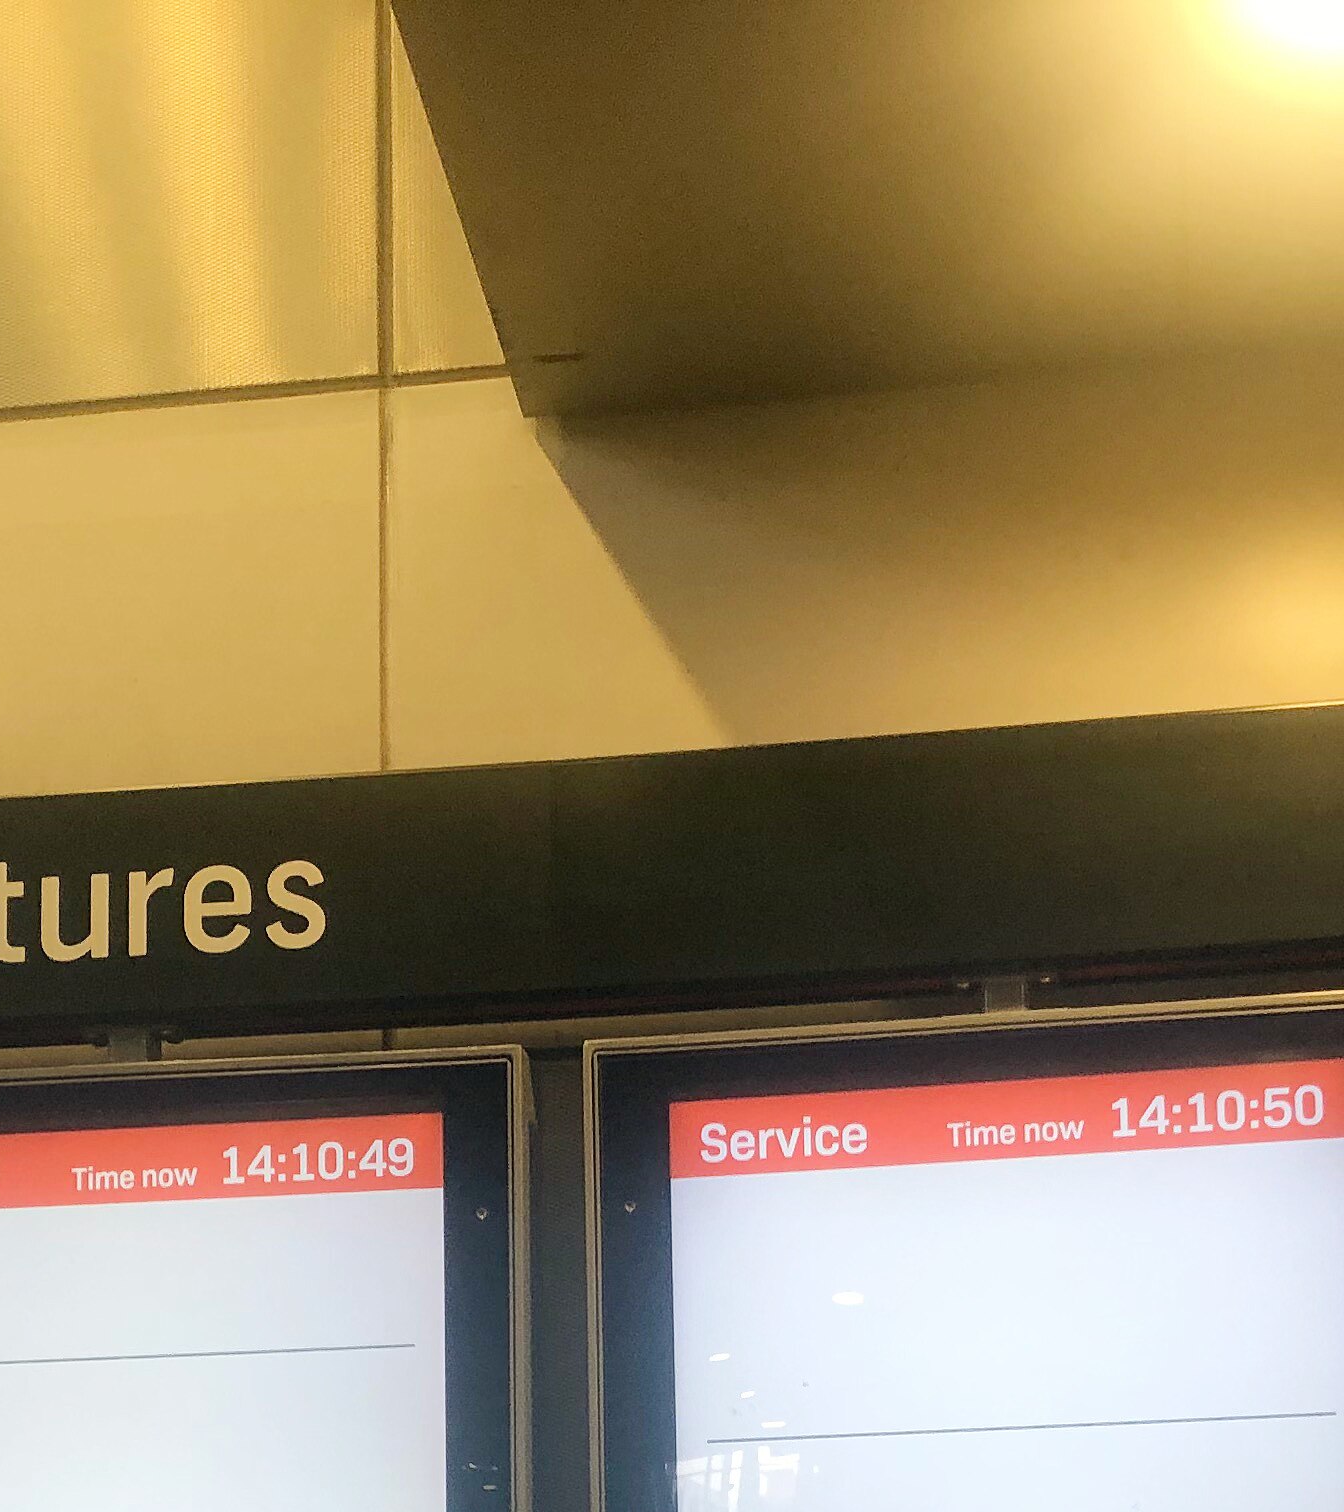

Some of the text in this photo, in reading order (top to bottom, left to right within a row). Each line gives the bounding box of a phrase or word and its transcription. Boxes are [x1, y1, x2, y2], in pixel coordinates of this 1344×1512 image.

[700, 1115, 868, 1163] Service
[946, 1084, 1326, 1148] Time now 14:10:50
[71, 1137, 415, 1191] Time now 14:10:49
